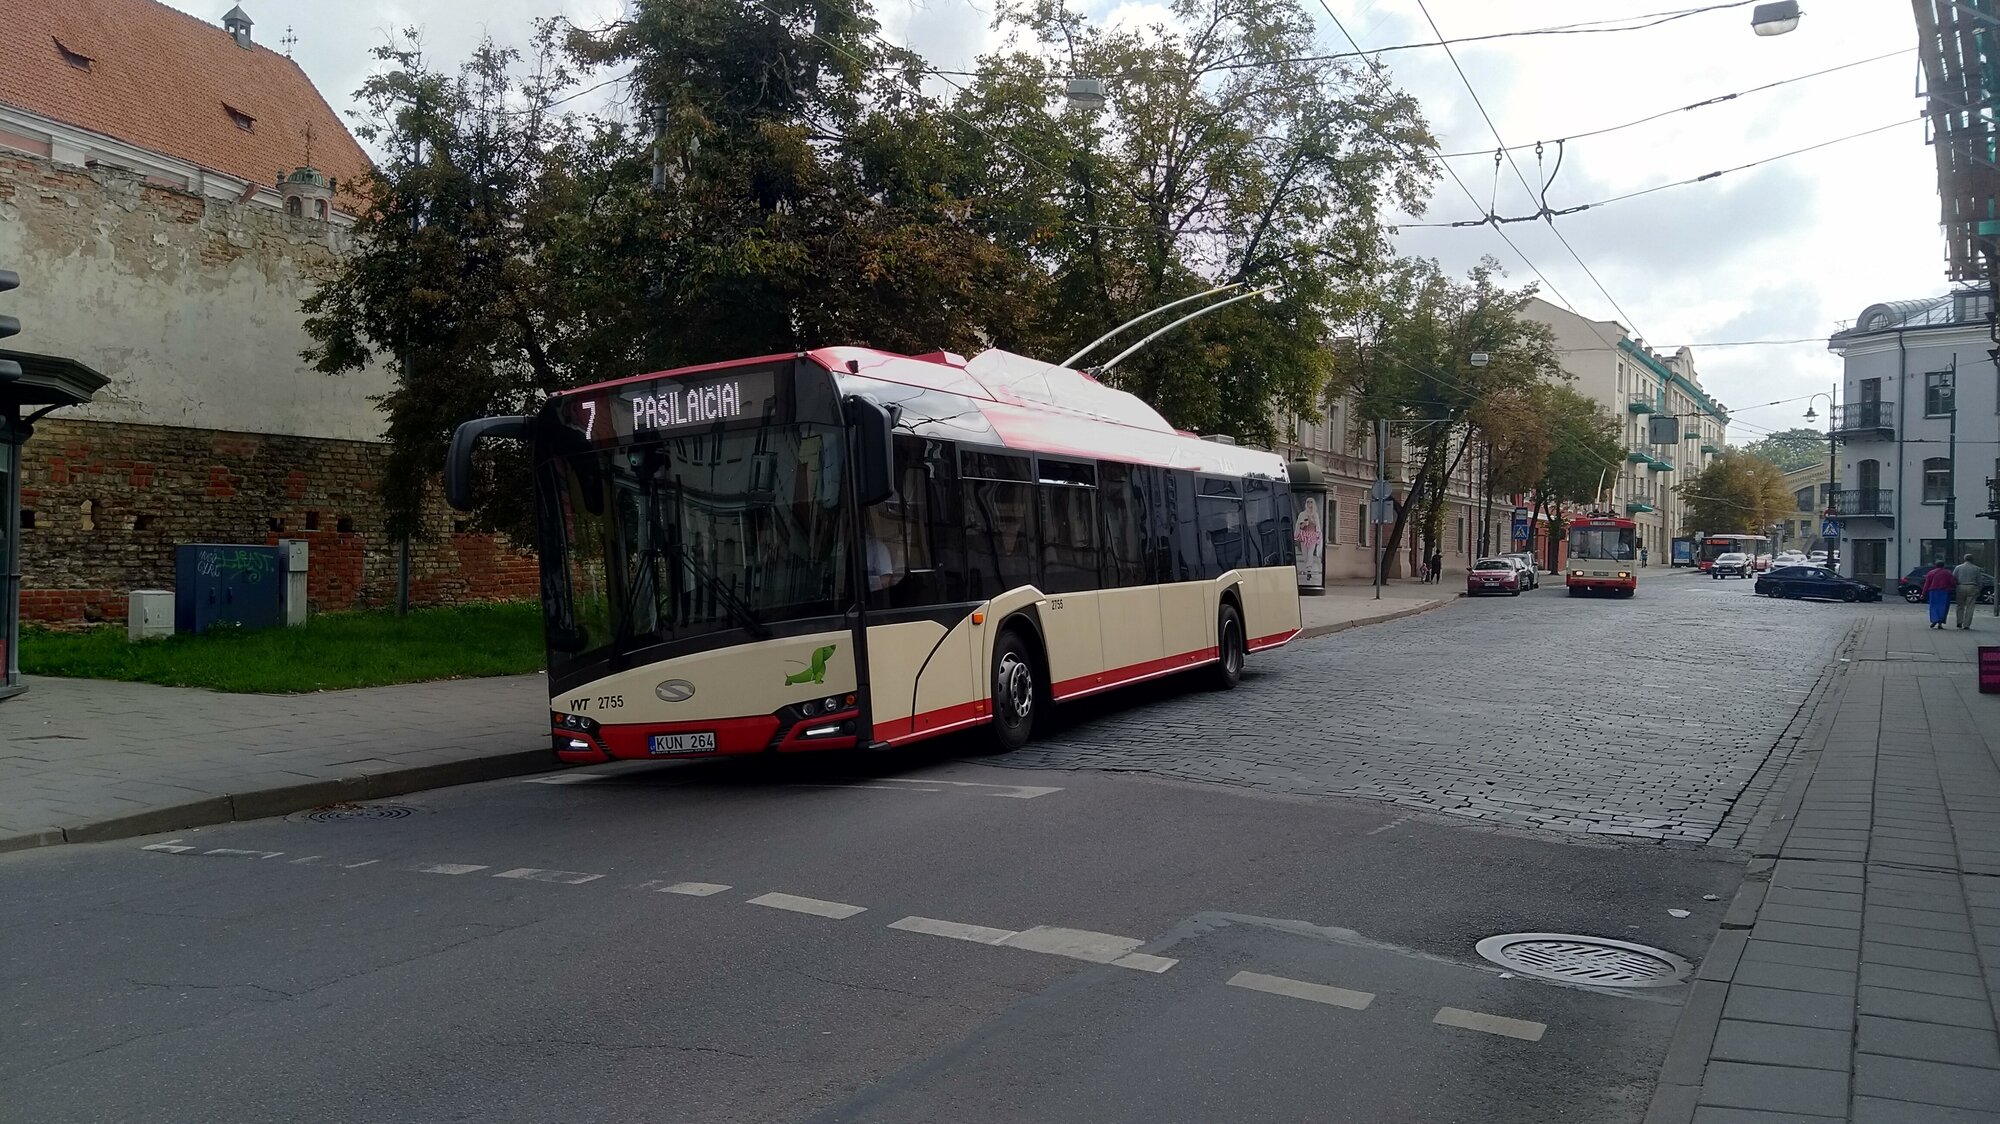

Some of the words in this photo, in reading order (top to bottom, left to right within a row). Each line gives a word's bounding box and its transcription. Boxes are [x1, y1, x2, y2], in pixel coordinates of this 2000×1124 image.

[582, 401, 596, 440] 7
[633, 382, 741, 430] PAŠILAIČIAI
[1051, 599, 1064, 610] 2755
[598, 695, 624, 709] 2755
[656, 736, 683, 750] KUN
[690, 734, 713, 748] 264
